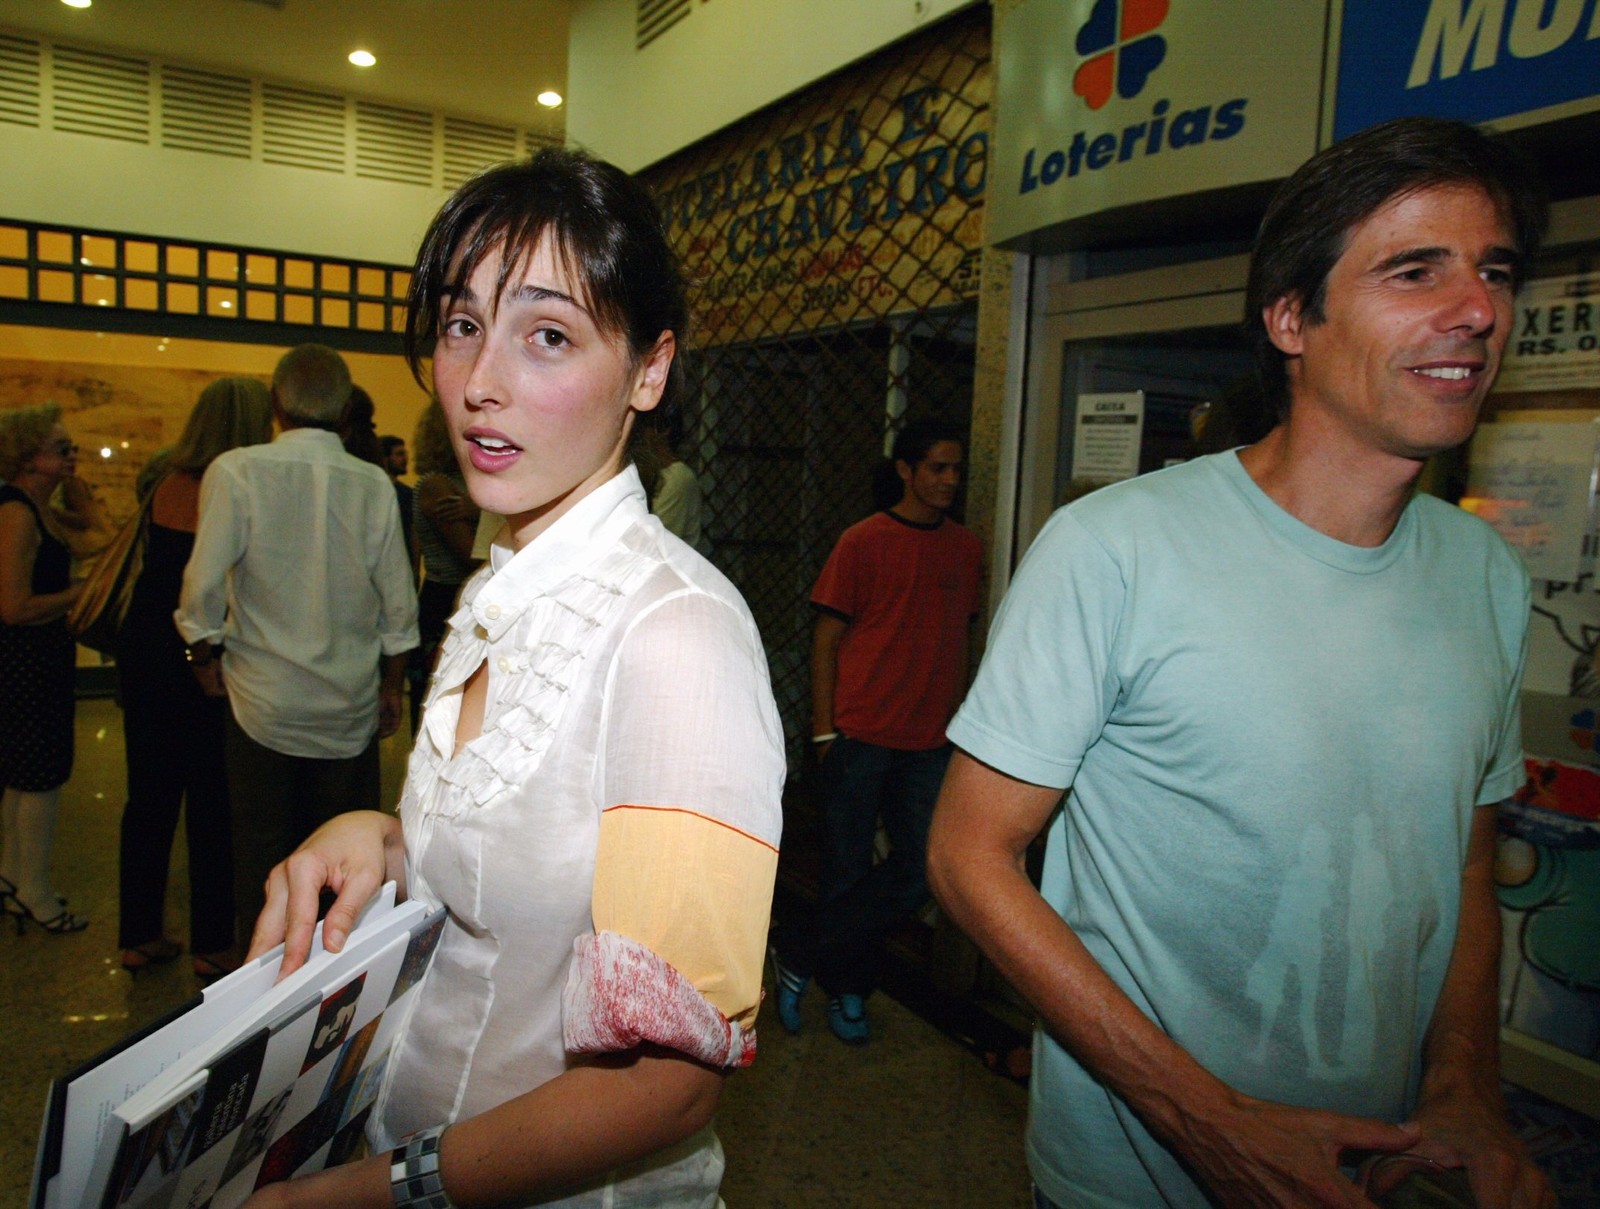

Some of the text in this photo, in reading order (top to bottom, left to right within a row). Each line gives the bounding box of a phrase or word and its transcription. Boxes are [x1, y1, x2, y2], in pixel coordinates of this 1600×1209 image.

[899, 86, 942, 145] E
[1019, 98, 1249, 195] Loterias
[727, 132, 989, 264] CHAVEIRO
[1521, 302, 1600, 337] XER
